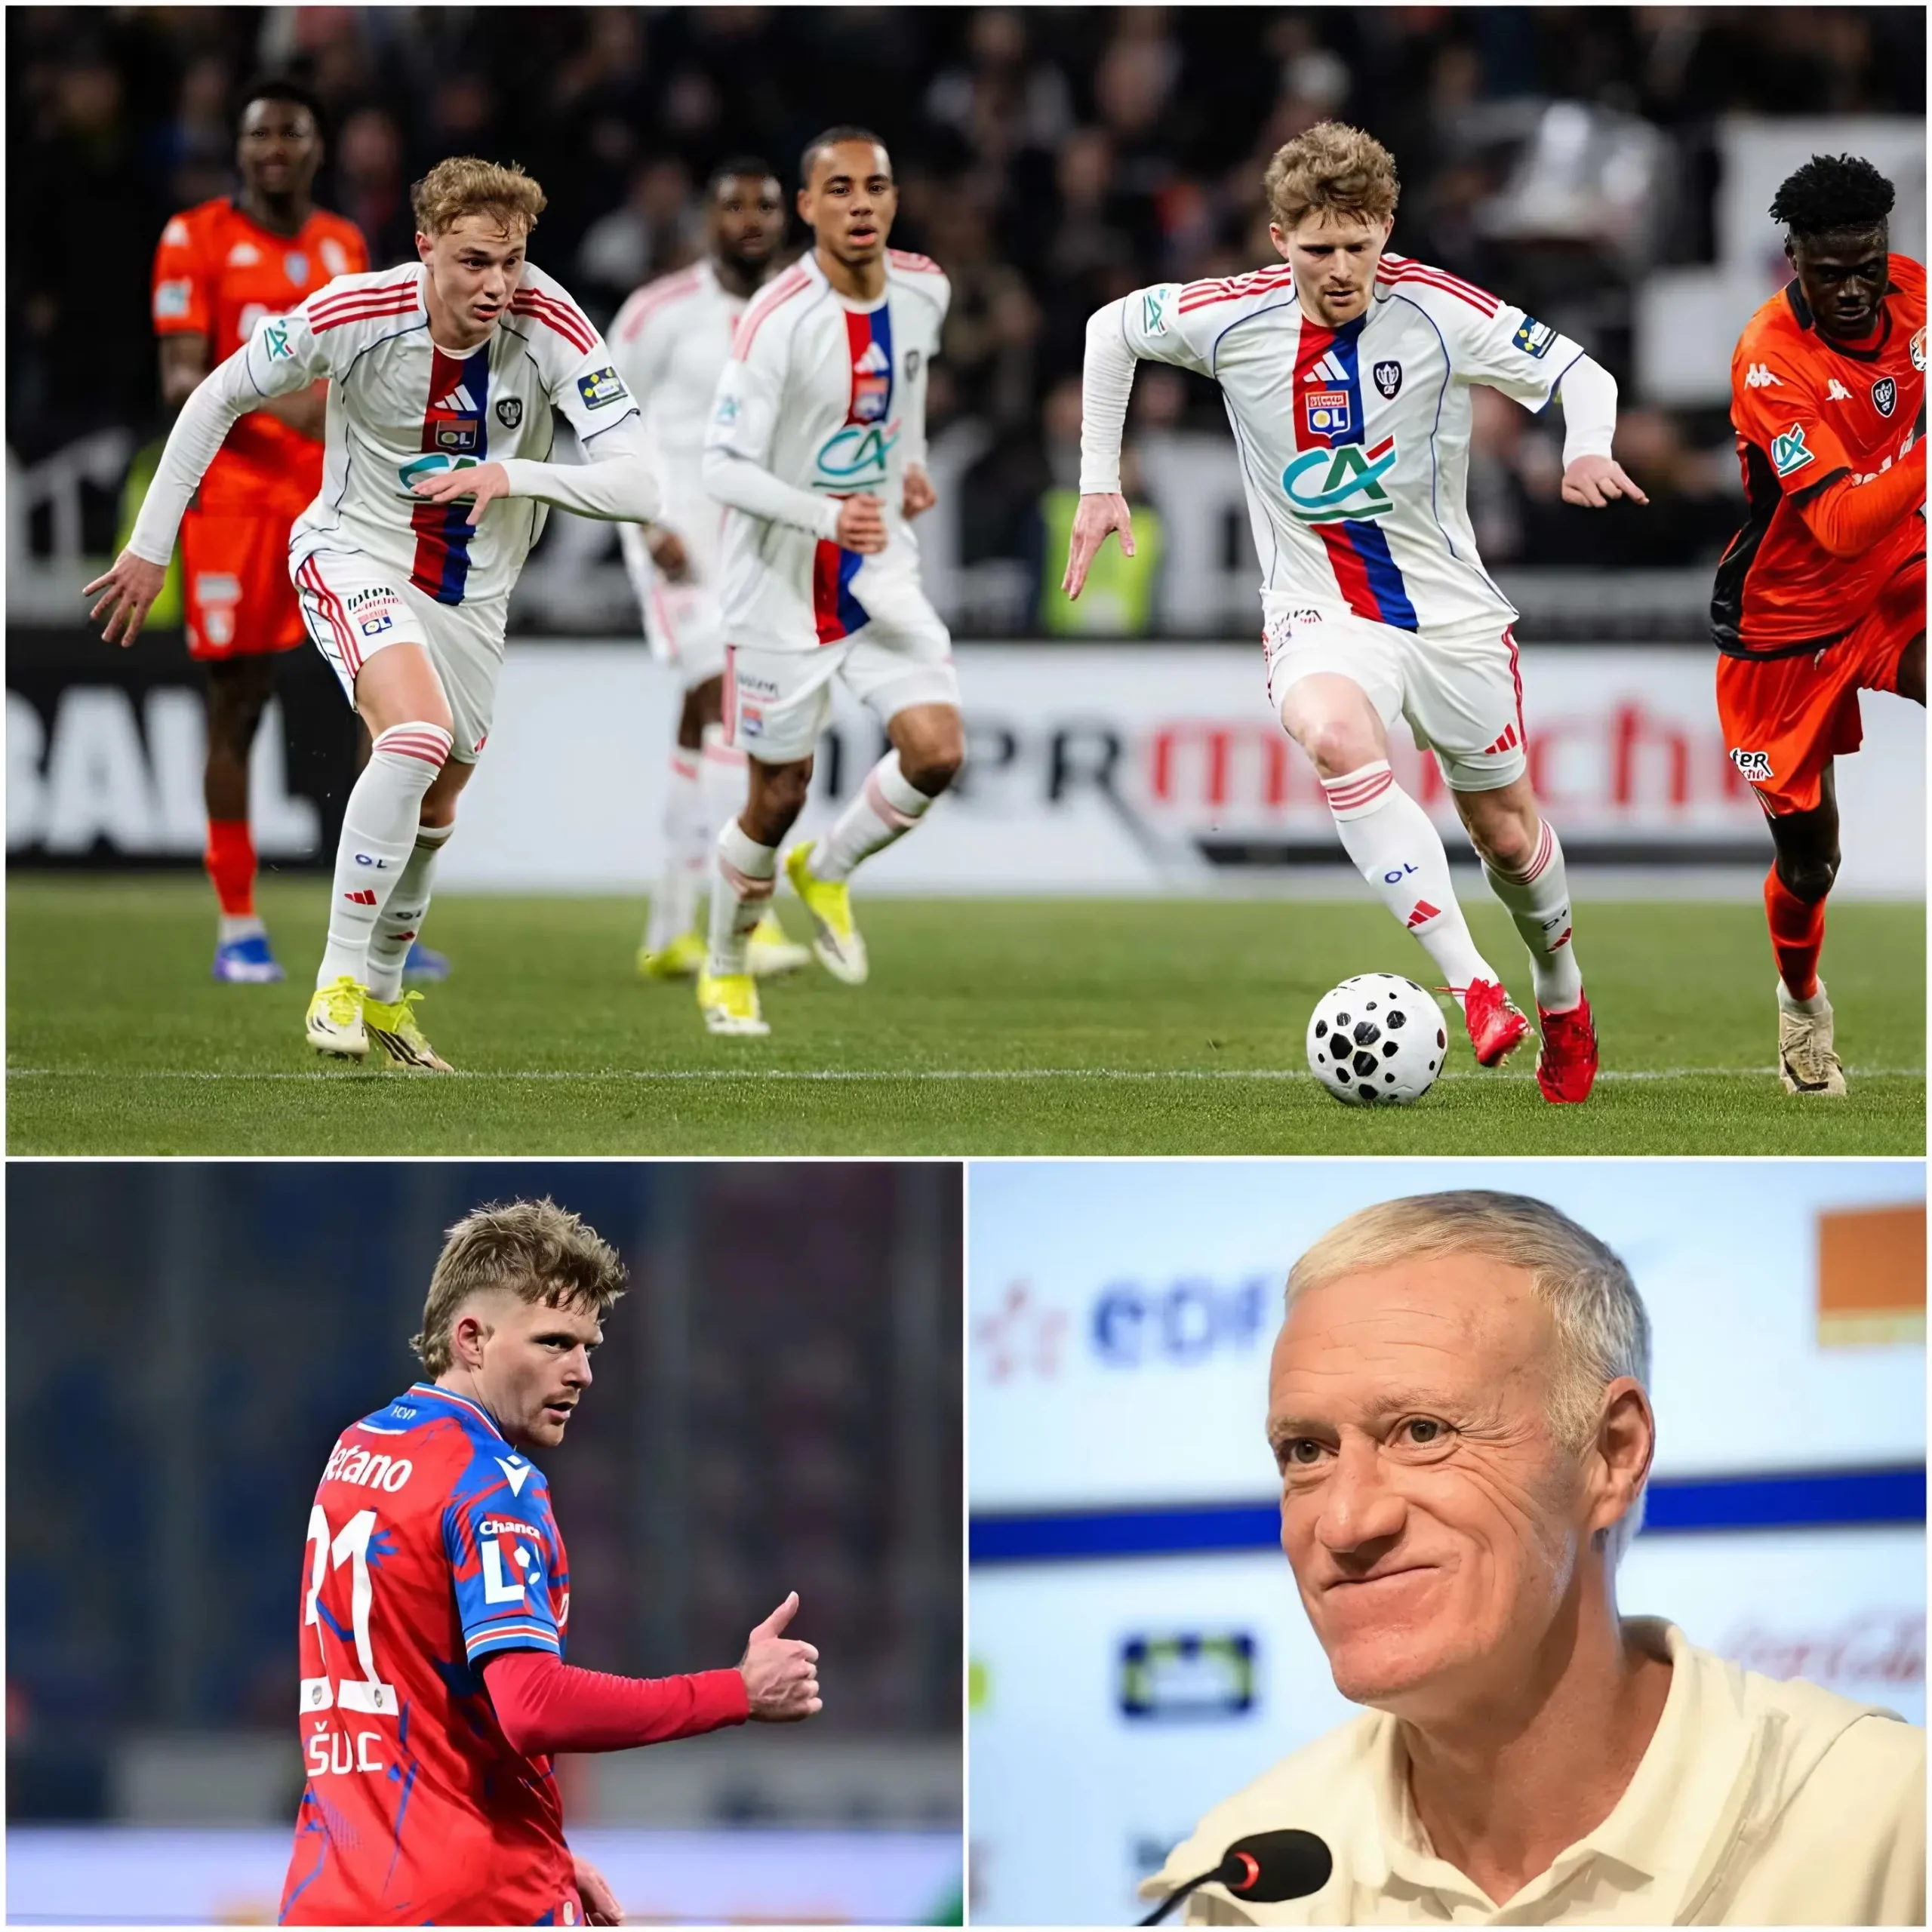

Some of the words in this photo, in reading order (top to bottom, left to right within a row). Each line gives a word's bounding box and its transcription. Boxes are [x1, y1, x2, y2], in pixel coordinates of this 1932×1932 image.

[1312, 409, 1346, 429] OL
[1282, 442, 1396, 509] CA
[355, 854, 387, 869] OL
[1384, 863, 1420, 884] OL
[307, 1720, 383, 1777] ŠUC
